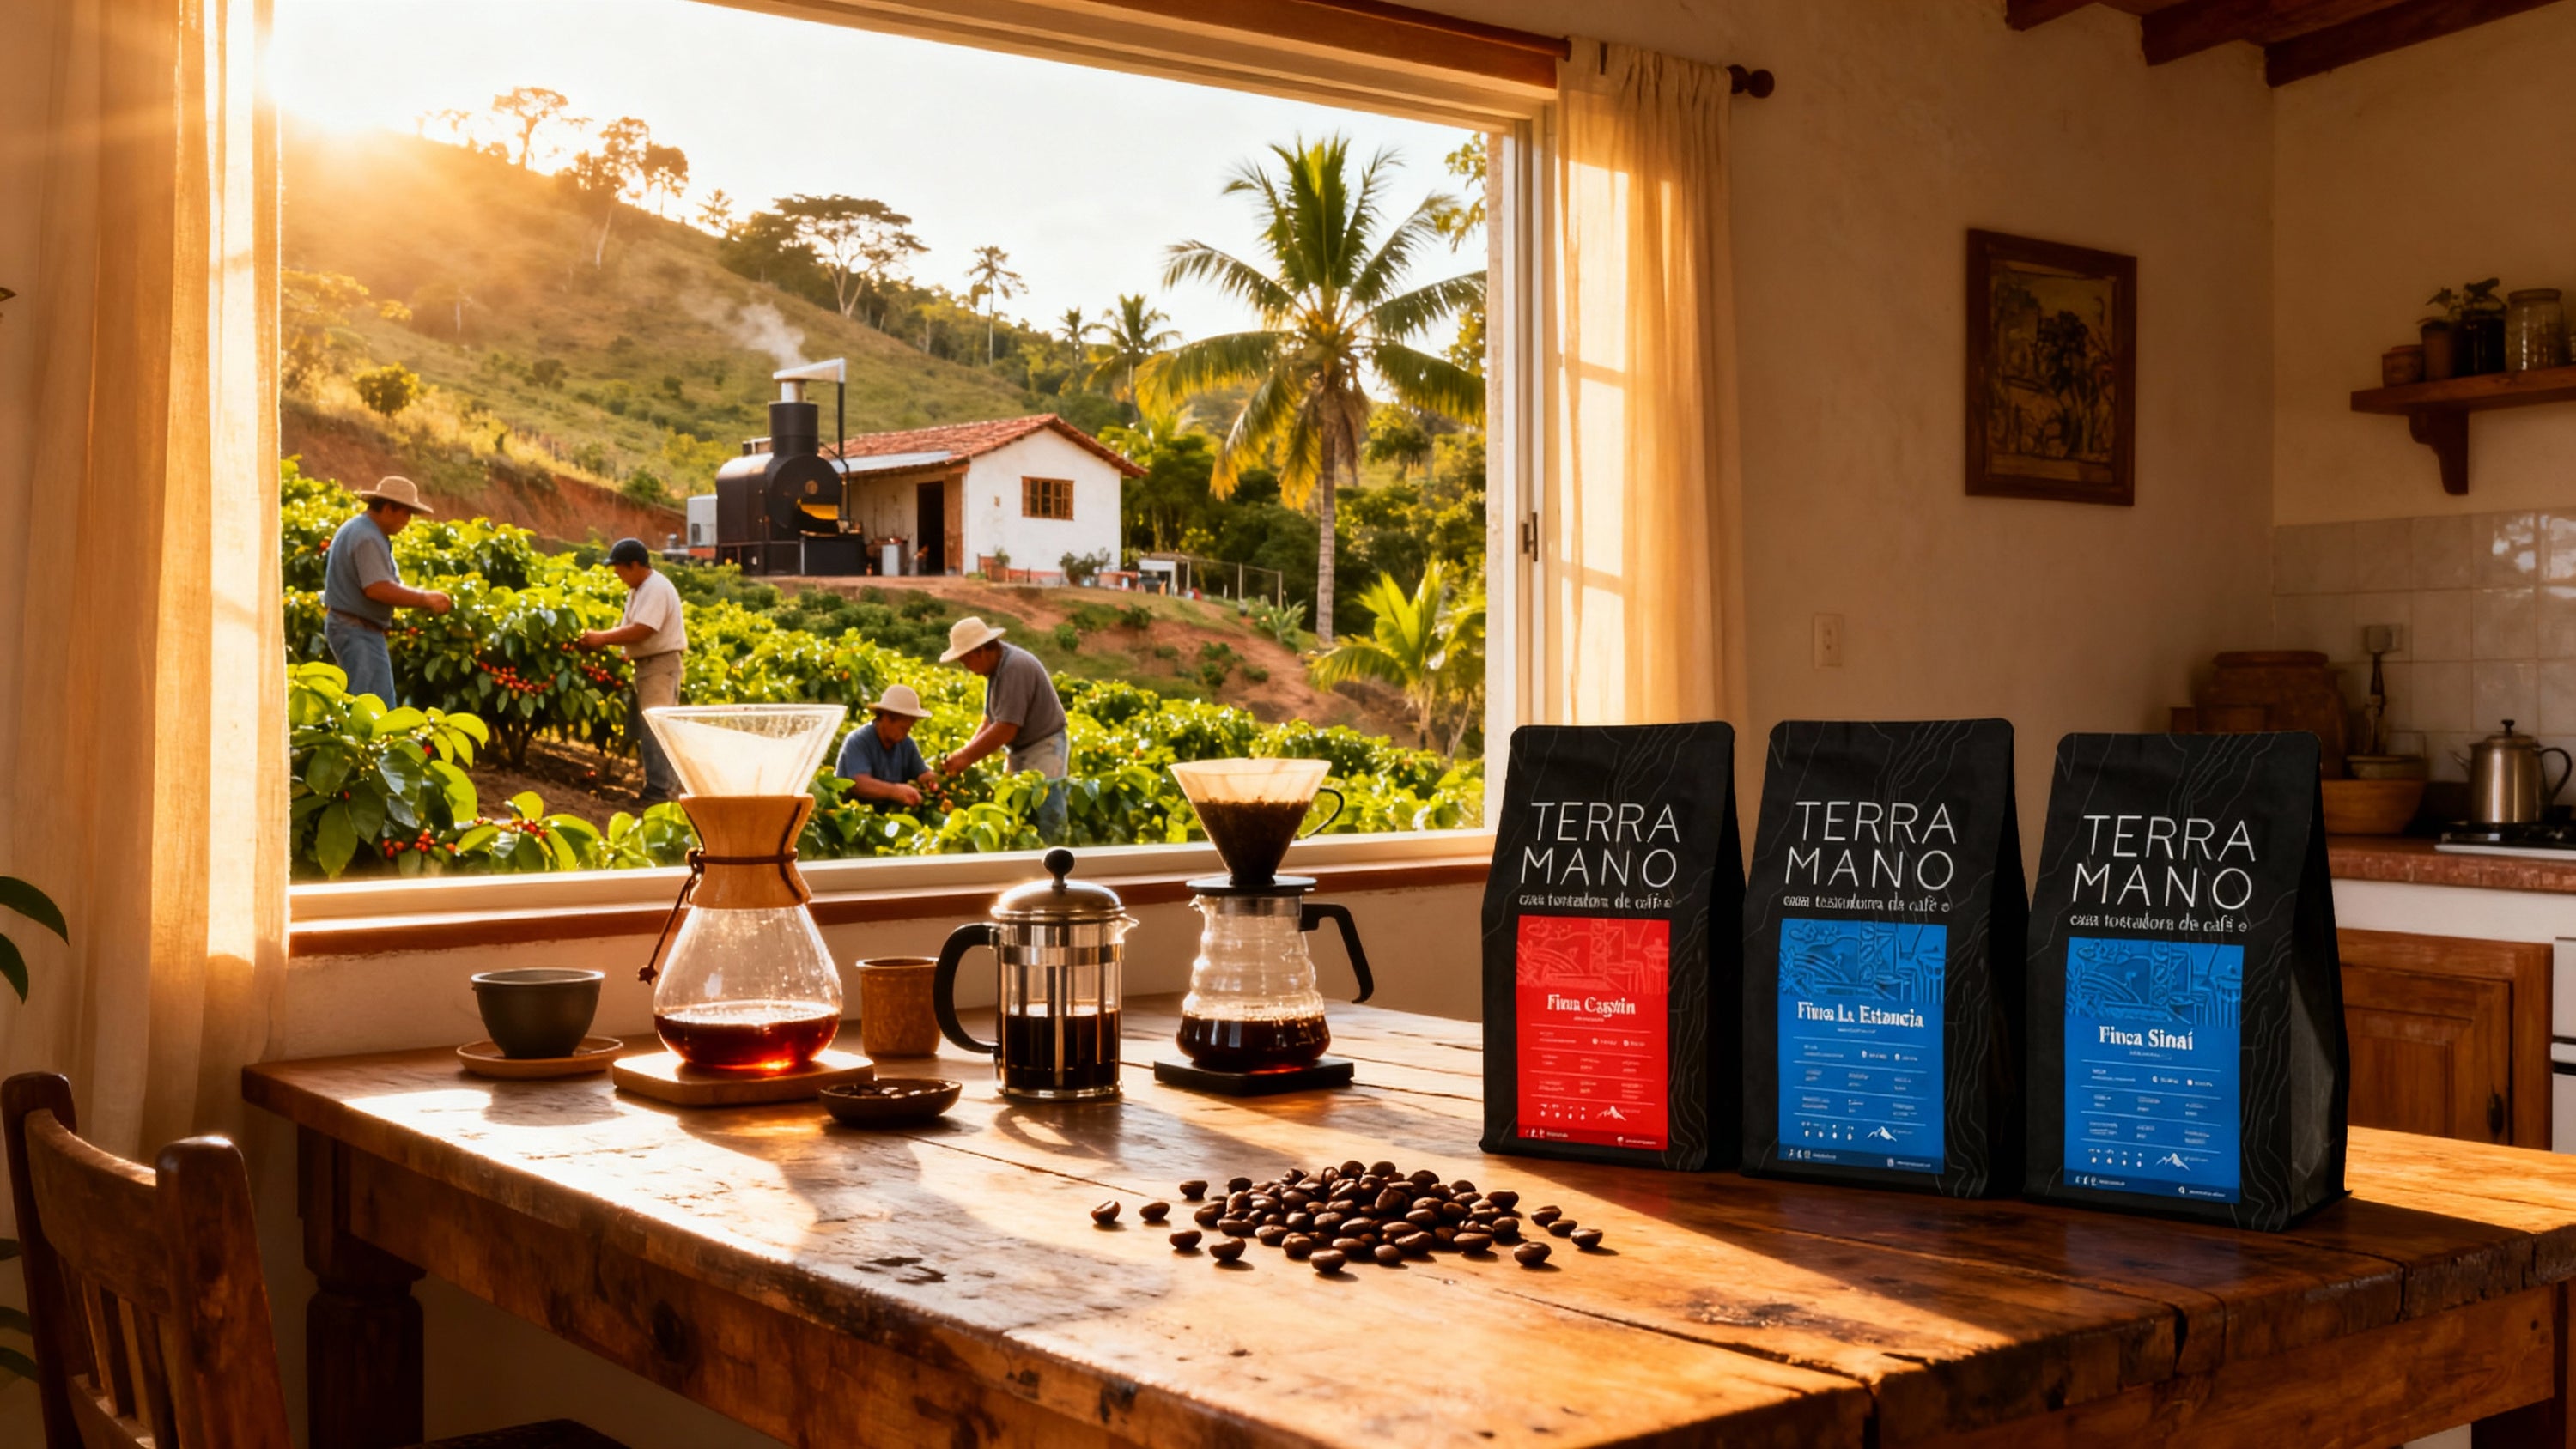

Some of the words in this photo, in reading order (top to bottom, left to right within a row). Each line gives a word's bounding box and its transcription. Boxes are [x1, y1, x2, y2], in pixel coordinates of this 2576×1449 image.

[1531, 802, 1680, 843] TERRA
[1795, 801, 1957, 845] TERRA
[2083, 815, 2256, 862] TERRA
[1521, 846, 1677, 888] MANO
[1785, 846, 1954, 891] MANO
[2072, 863, 2252, 910] MANO
[1614, 891, 1631, 908] de
[2178, 912, 2199, 931] de
[2099, 1026, 2143, 1046] Finca
[2148, 1028, 2193, 1050] Sinaí
